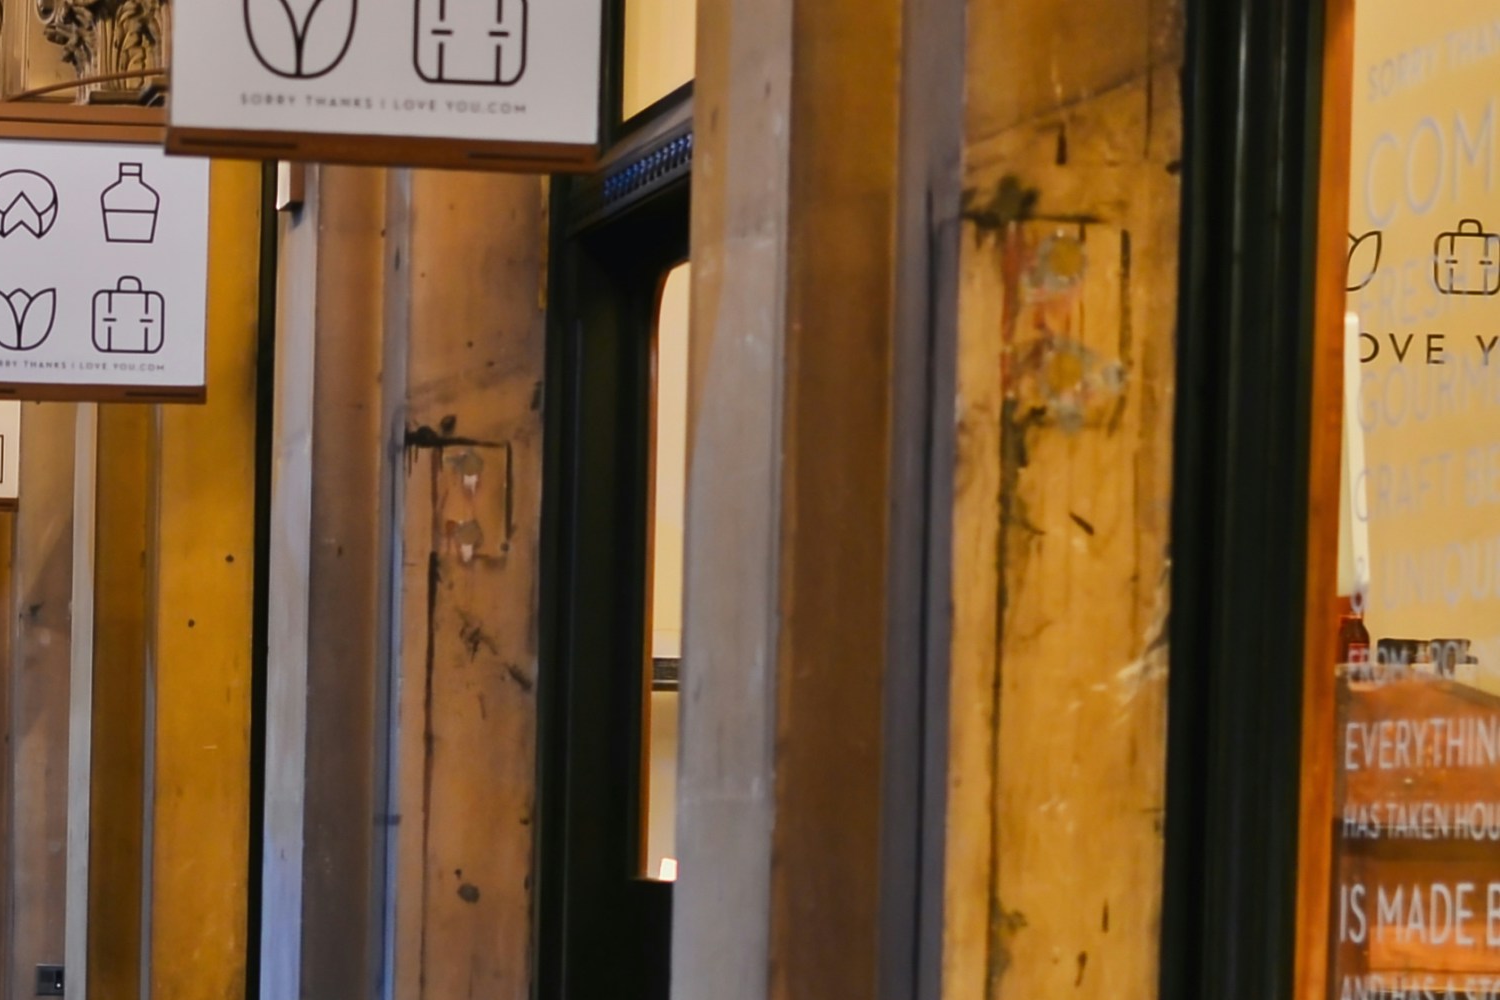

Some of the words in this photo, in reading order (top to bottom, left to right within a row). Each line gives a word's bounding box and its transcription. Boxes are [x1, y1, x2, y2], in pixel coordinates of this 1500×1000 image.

[305, 95, 374, 110] THANKS
[393, 98, 436, 112] LOVE
[23, 360, 67, 371] THANKS
[79, 362, 108, 371] LOVE
[1345, 716, 1500, 770] EVERYTHIN
[1342, 803, 1379, 839] HAS
[1387, 802, 1449, 840] TAKEN
[1340, 884, 1366, 943] IS
[1377, 883, 1475, 945] MADE
